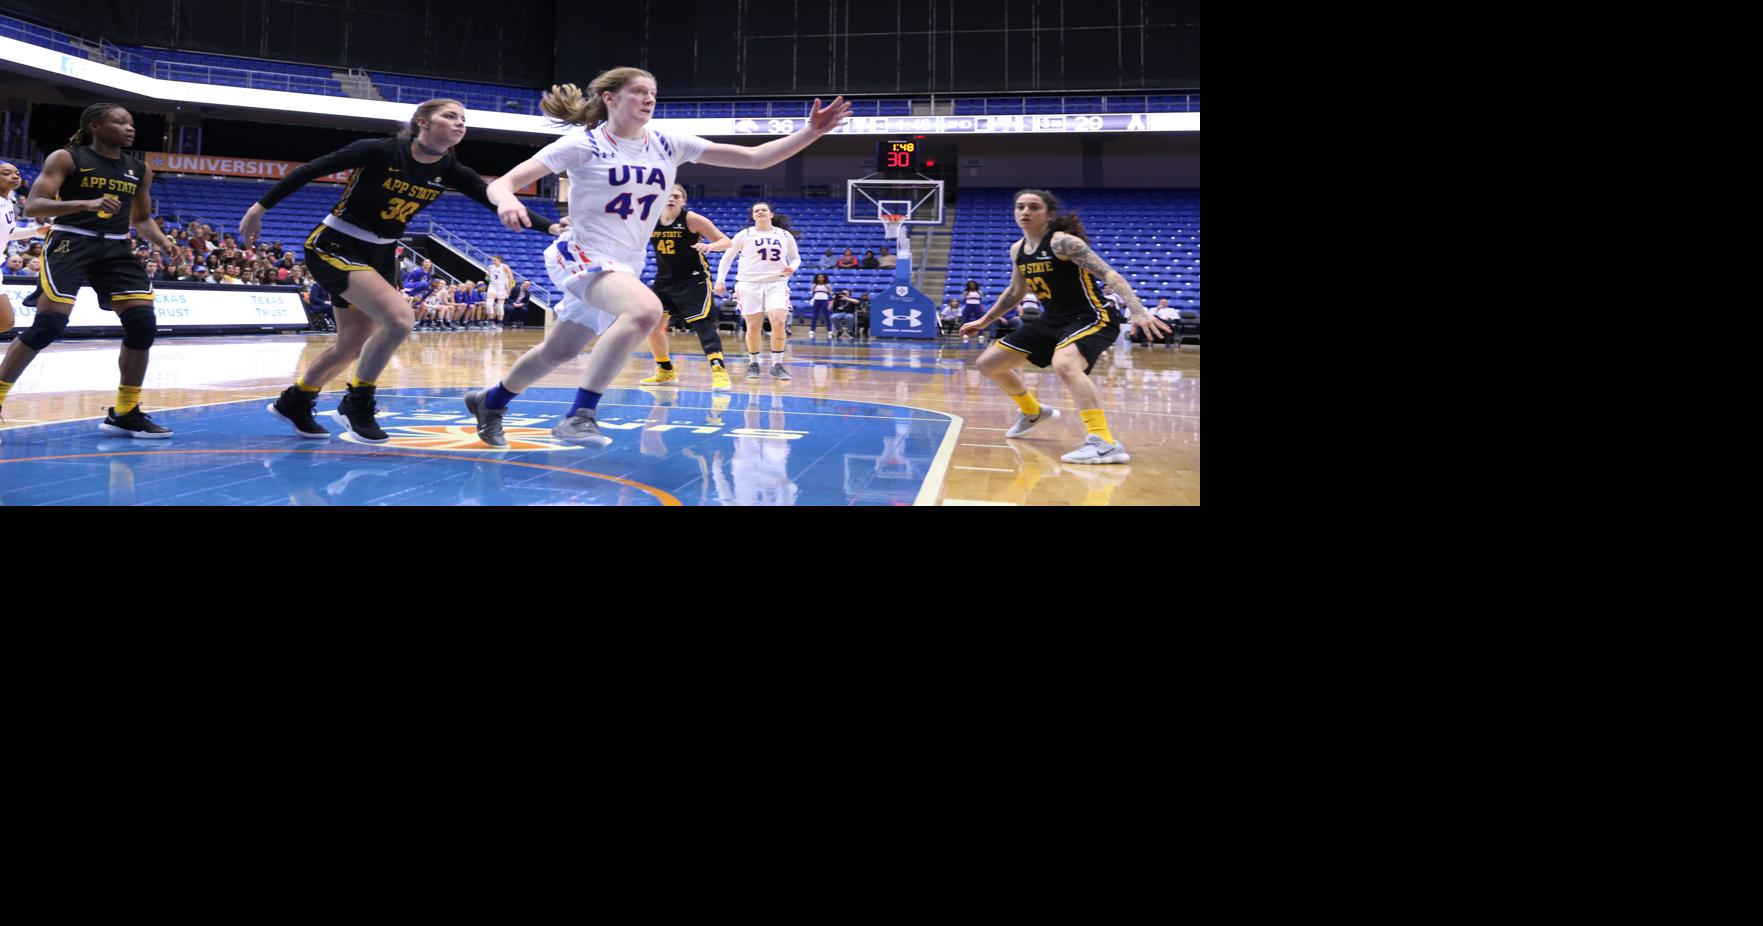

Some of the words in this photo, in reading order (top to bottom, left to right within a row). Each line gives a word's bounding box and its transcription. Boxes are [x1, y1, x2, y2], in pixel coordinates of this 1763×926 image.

[768, 119, 793, 133] 36
[1075, 116, 1104, 131] 29
[892, 143, 915, 152] 1:48
[167, 156, 289, 176] UNIVERSITY
[887, 151, 909, 167] 30
[81, 176, 107, 189] APP
[608, 165, 666, 191] UTA
[382, 177, 410, 194] APP
[408, 185, 440, 201] STATE
[604, 192, 658, 221] 41
[657, 239, 676, 255] 42
[755, 237, 782, 248] UTA
[757, 247, 781, 262] 13
[1026, 261, 1054, 274] STATE
[251, 295, 285, 305] TEXAS
[256, 307, 287, 317] TRUST
